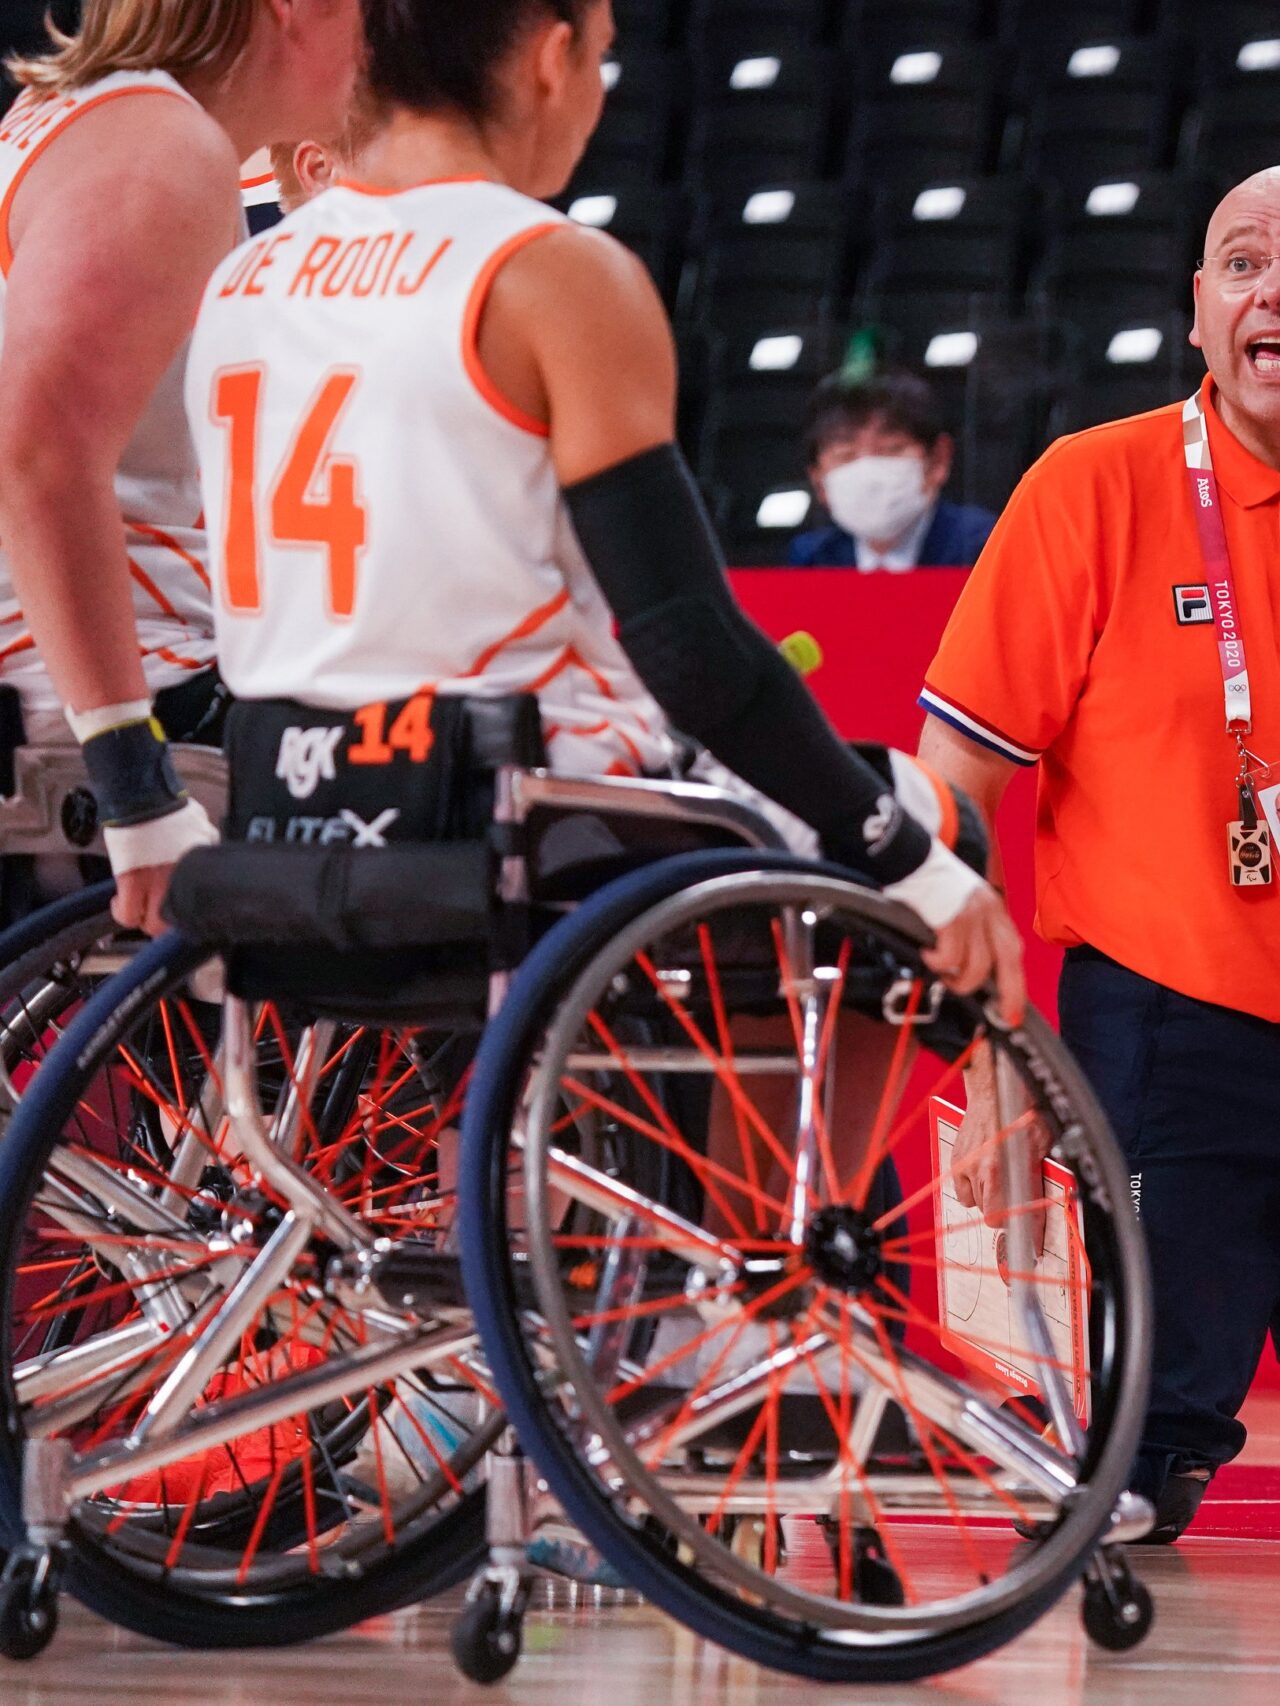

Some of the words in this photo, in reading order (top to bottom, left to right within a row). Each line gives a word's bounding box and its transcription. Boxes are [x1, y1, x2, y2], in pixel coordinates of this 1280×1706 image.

[217, 232, 294, 298] DE
[287, 231, 454, 298] ROOIJ
[211, 362, 369, 621] 14
[1197, 477, 1213, 508] Atos
[1214, 580, 1235, 629] TOKYO
[1222, 631, 1241, 668] 2020
[348, 683, 436, 765] 14
